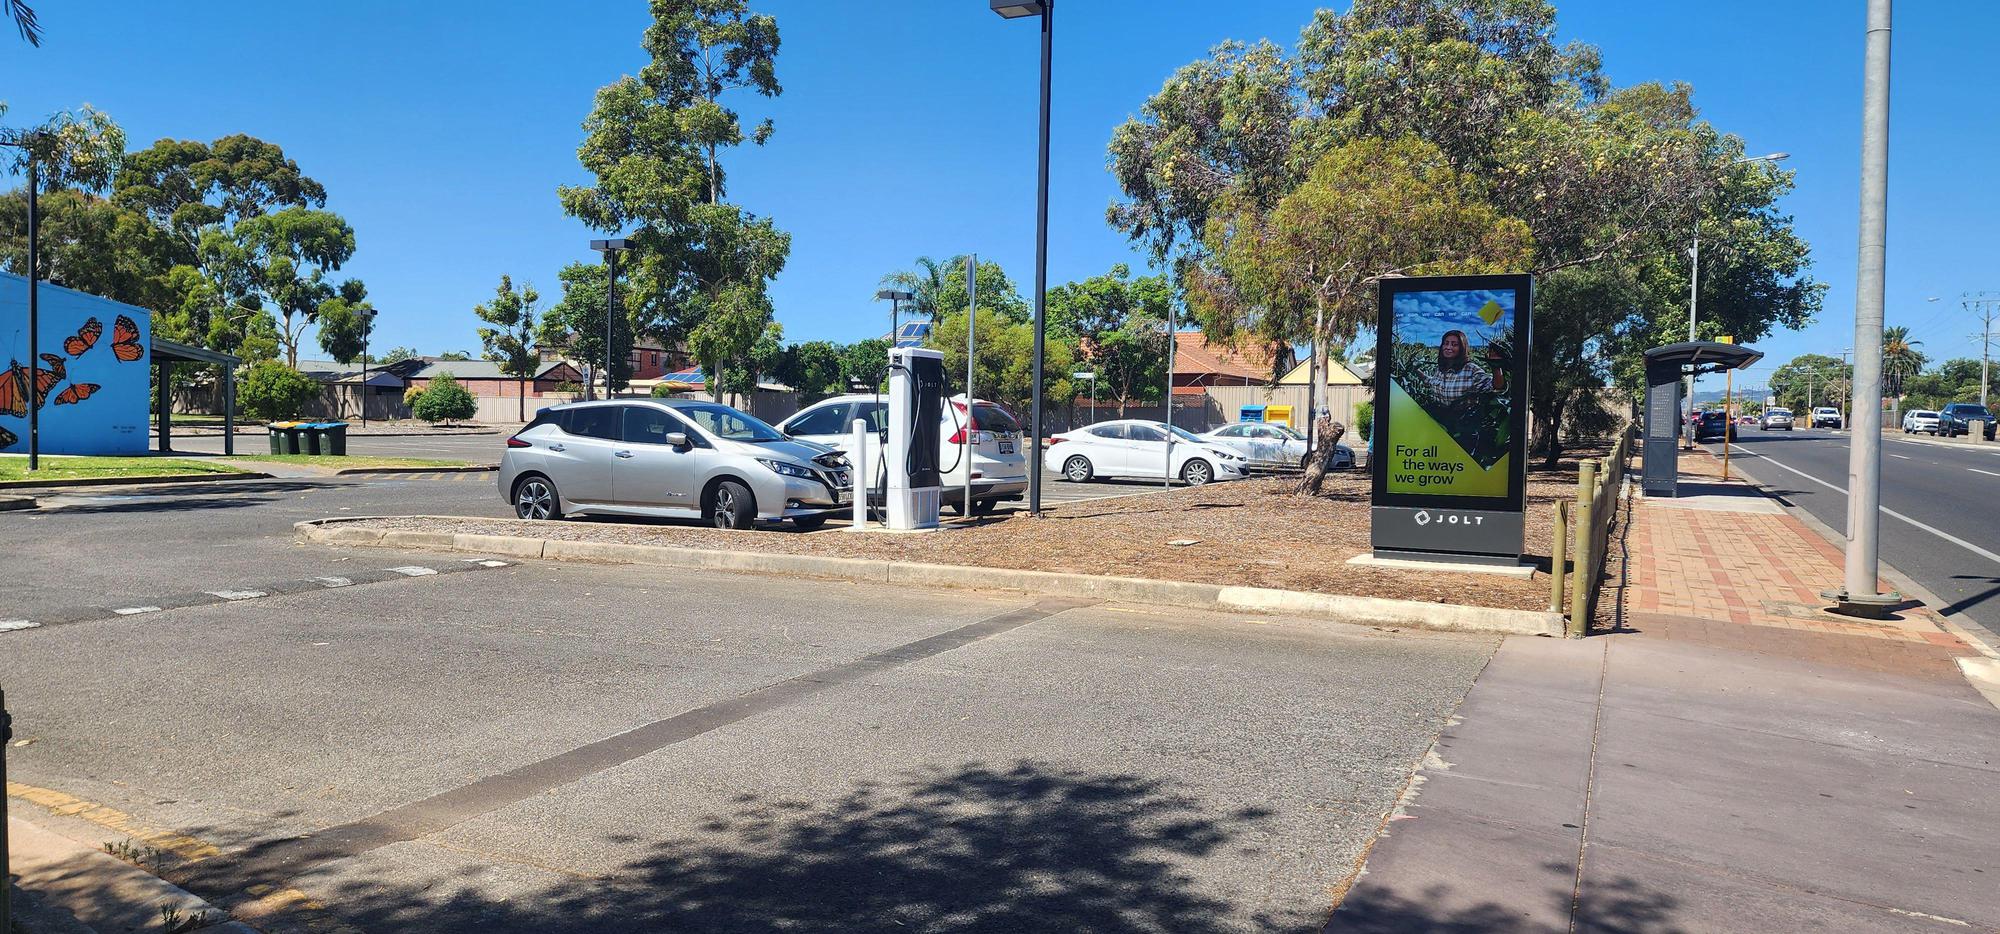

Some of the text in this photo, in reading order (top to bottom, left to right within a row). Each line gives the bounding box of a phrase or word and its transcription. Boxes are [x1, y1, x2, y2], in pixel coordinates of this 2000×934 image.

[1396, 445, 1437, 457] For all
[1403, 459, 1464, 474] the ways
[1395, 474, 1454, 486] we grow
[1436, 515, 1483, 525] JOLT
